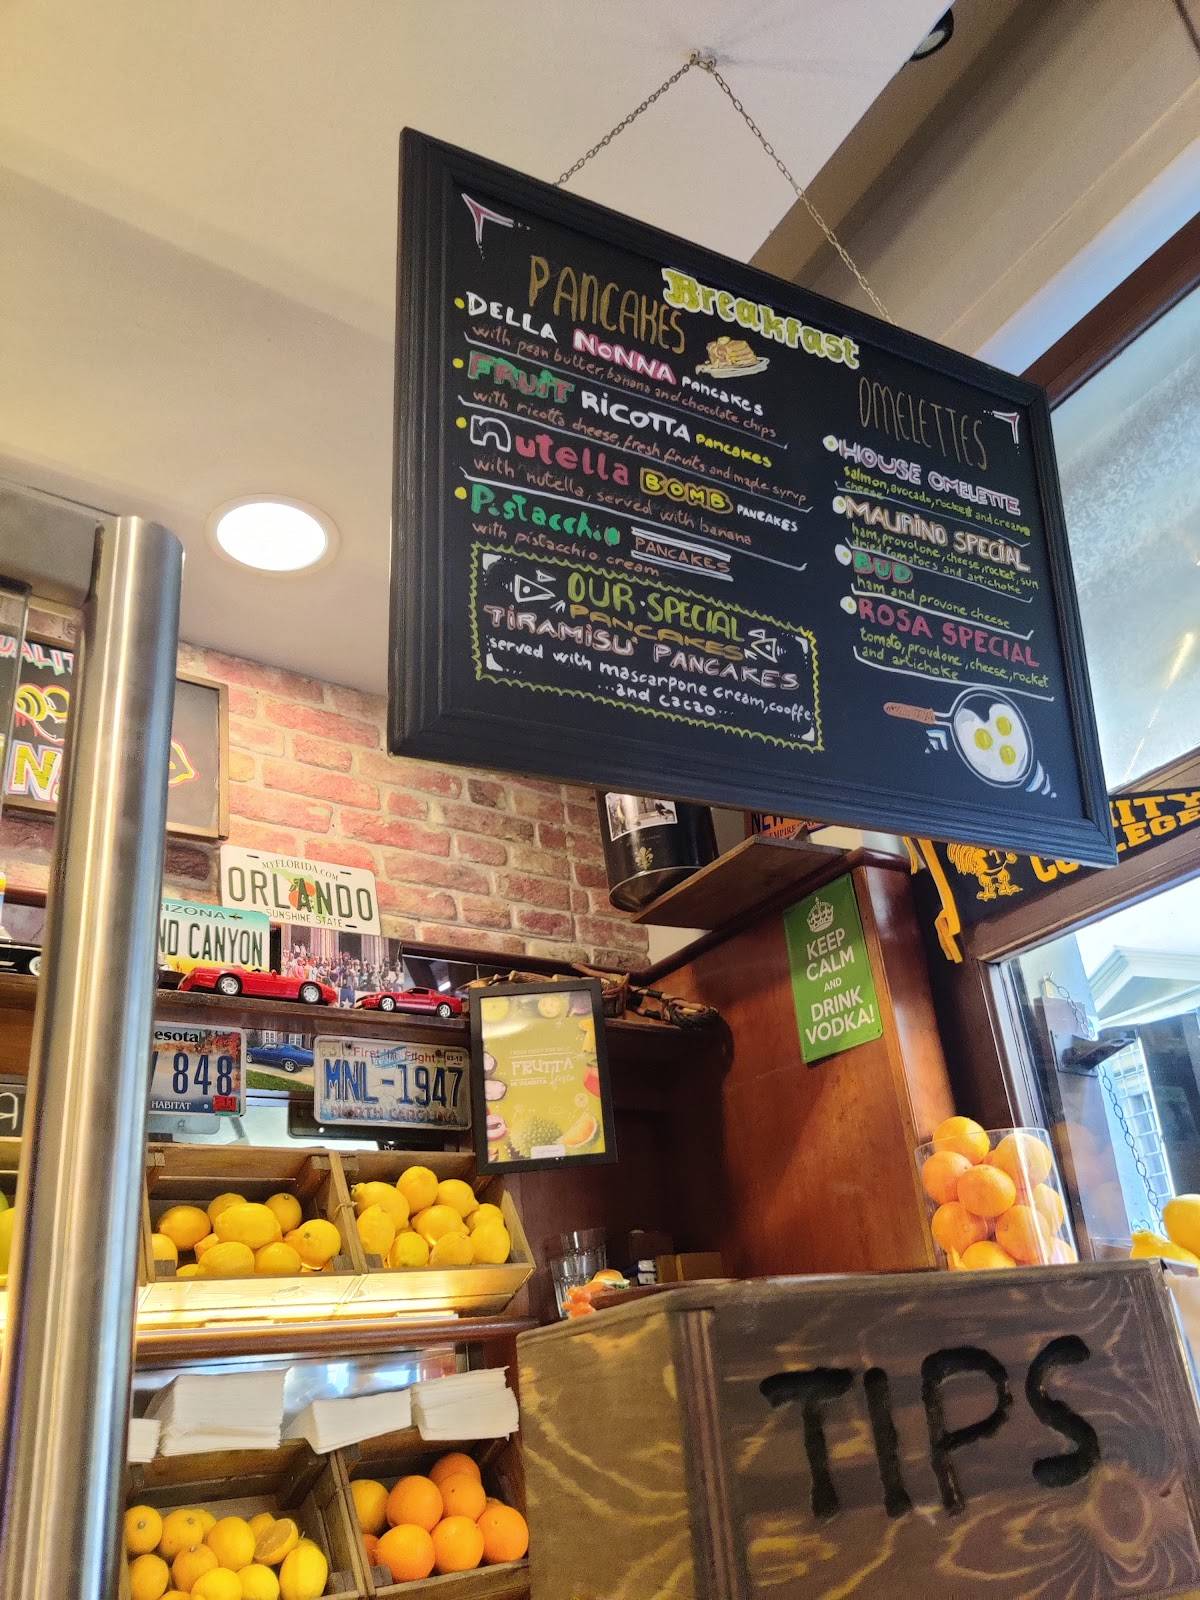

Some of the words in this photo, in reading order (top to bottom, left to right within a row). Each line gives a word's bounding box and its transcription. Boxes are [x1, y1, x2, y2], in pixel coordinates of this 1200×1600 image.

[466, 291, 558, 343] DELLA
[528, 255, 686, 355] PANCAKES
[661, 267, 860, 370] Breakfast
[472, 326, 511, 346] with
[517, 341, 549, 360] pean
[743, 418, 777, 438] chips
[473, 390, 508, 409] with
[516, 403, 565, 426] ricotta
[662, 447, 706, 473] fruits
[709, 467, 731, 480] and
[859, 376, 987, 471] OMELETTES
[473, 458, 515, 478] with
[597, 491, 652, 514] served
[660, 509, 695, 529] with
[700, 517, 752, 545] banana
[640, 467, 734, 514] BOMB
[736, 504, 799, 532] PANCAKES
[838, 439, 922, 485] HOUSE
[928, 470, 1021, 517] OMELETTE
[845, 496, 949, 547] MAURINO
[953, 531, 1031, 574] SPECIAL
[975, 512, 993, 525] and
[472, 521, 507, 540] with
[515, 530, 598, 561] pistacchio
[606, 556, 660, 577] cream
[635, 536, 732, 573] PANCAKES
[857, 575, 886, 594] ham
[890, 588, 915, 602] and
[970, 607, 1011, 630] cheese
[943, 565, 962, 578] and
[967, 573, 1022, 595] artichoke
[1021, 577, 1039, 591] sun
[568, 572, 635, 615] OUR
[647, 592, 745, 642] SPECIAL
[858, 597, 933, 639] ROSA
[942, 622, 1041, 668] SPECIAL
[488, 636, 544, 659] served
[552, 650, 592, 672] with
[599, 661, 708, 697] mascarpone
[653, 643, 800, 690] PANCAKES
[862, 646, 885, 660] and
[892, 653, 959, 680] artichoke
[1012, 671, 1049, 688] rocket
[227, 865, 374, 922] ORLANDO
[265, 907, 311, 925] SUNSHINE
[315, 912, 344, 929] STATE
[188, 922, 264, 967] CANYON
[805, 945, 855, 981] CALM
[806, 928, 846, 961] KEEP
[810, 985, 864, 1023] DRINK
[823, 977, 842, 992] AND
[154, 1029, 199, 1043] esota
[804, 1004, 876, 1045] VODKA!
[172, 1051, 234, 1096] 848
[353, 1047, 380, 1059] First
[511, 1057, 574, 1076] FRUTTA
[151, 1100, 191, 1110] HABITAT
[323, 1058, 464, 1107] MNL-1947
[759, 1334, 1101, 1518] TIPS
